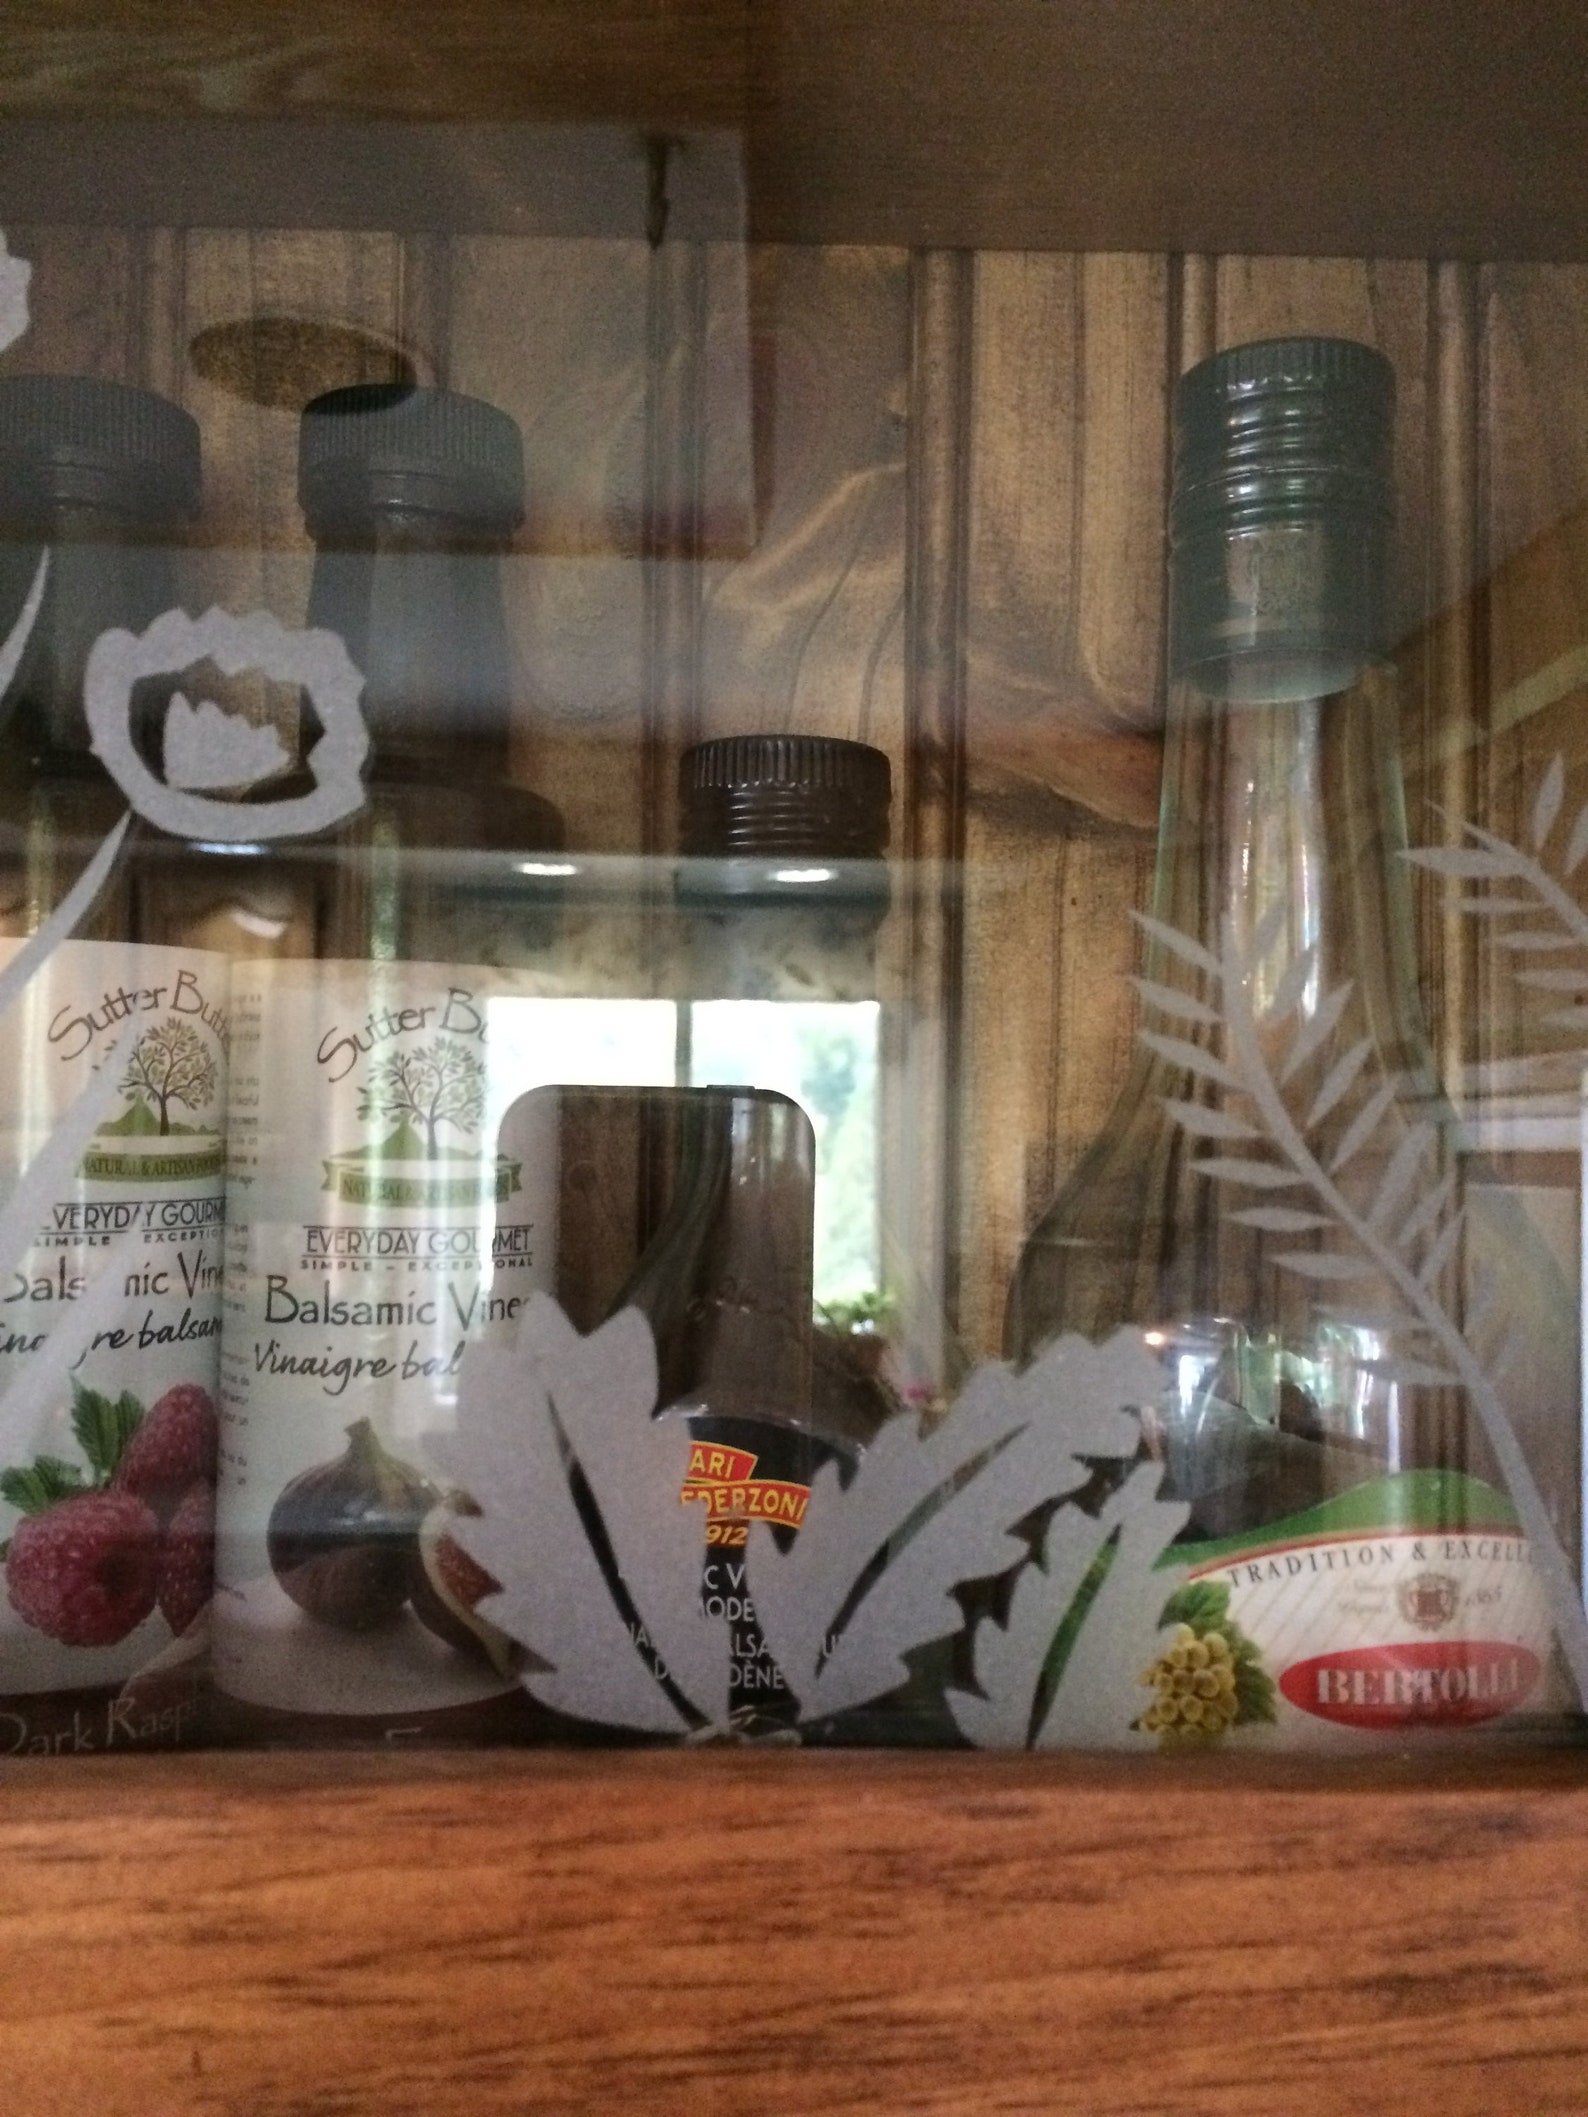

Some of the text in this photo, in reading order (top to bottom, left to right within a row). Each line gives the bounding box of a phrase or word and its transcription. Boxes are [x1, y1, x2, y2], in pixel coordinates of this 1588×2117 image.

[48, 986, 168, 1061] Sutter
[316, 1005, 436, 1082] Sutter
[301, 1259, 372, 1271] SIMPLE
[306, 1228, 531, 1254] EVERYDAY GOUMET
[264, 1274, 530, 1332] Balsamic Vine
[254, 1340, 396, 1396] Vinaigre
[1226, 1545, 1395, 1589] TRADITION
[1411, 1544, 1428, 1561] &
[1316, 1657, 1519, 1705] BERTOLLI
